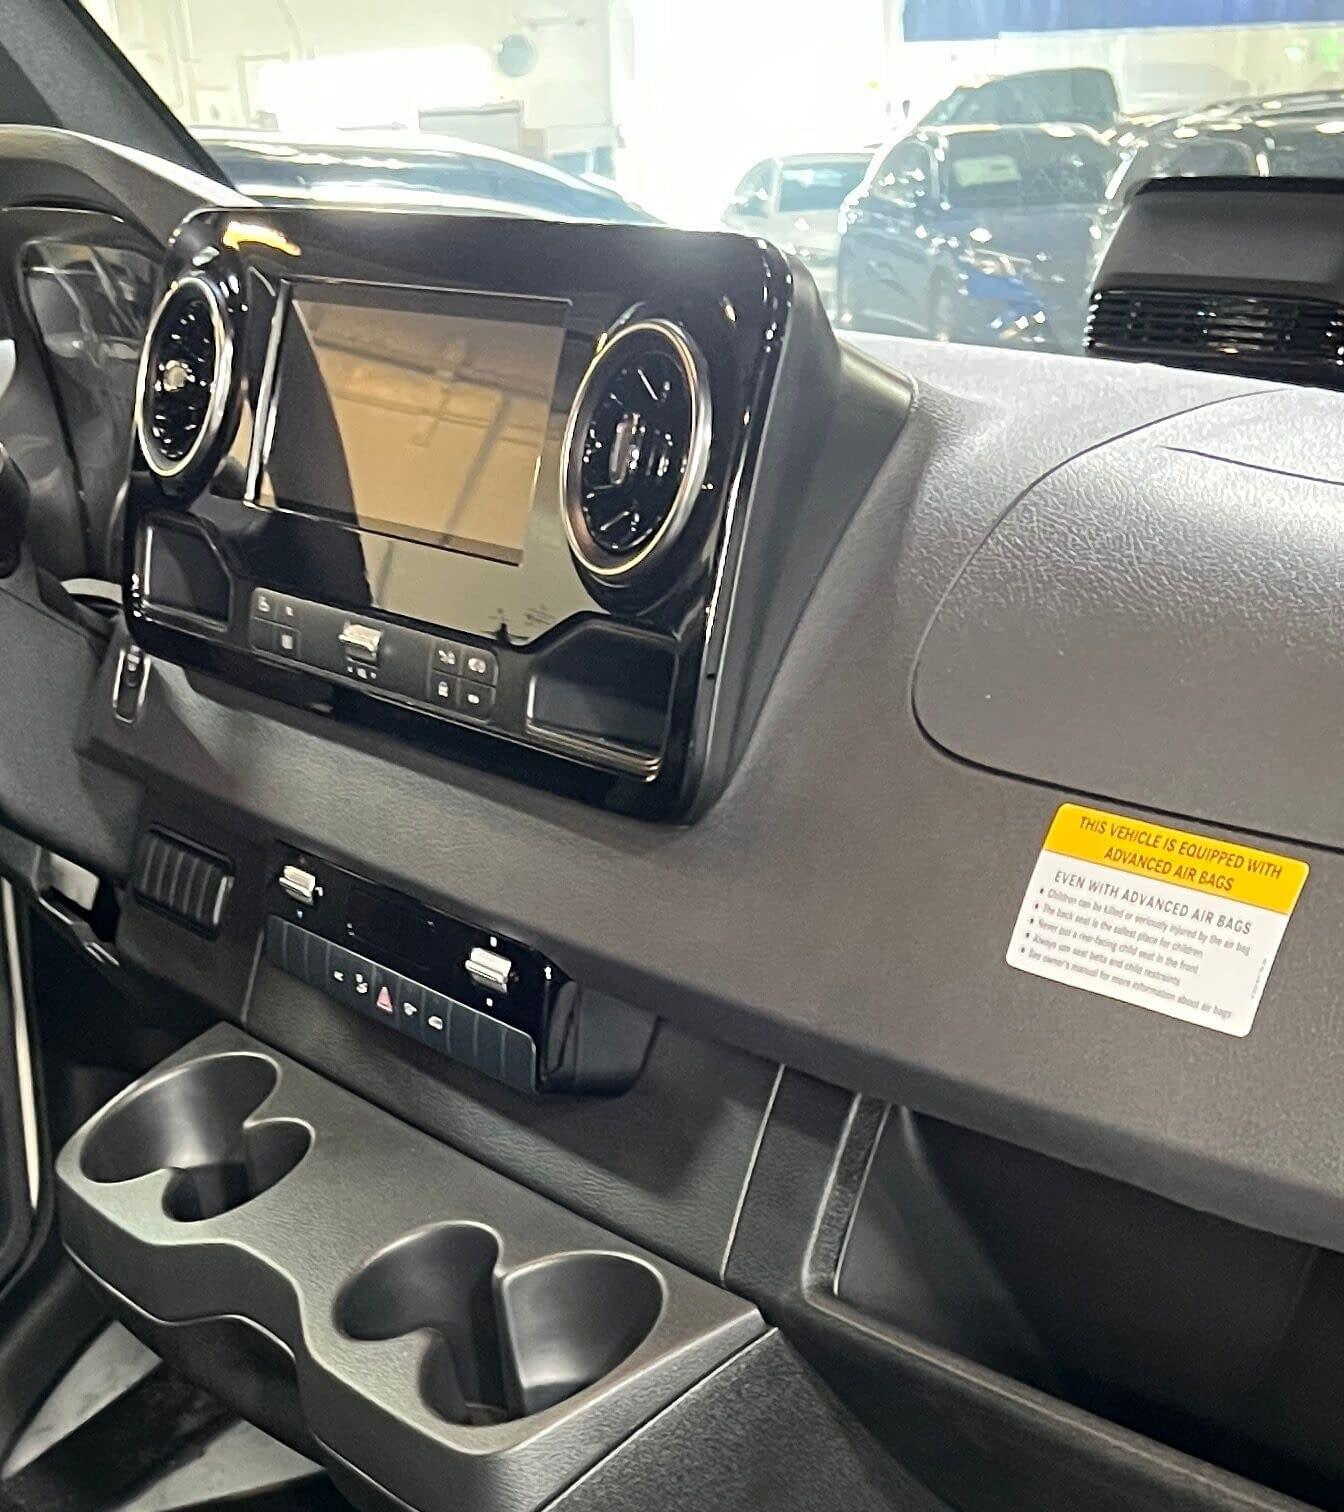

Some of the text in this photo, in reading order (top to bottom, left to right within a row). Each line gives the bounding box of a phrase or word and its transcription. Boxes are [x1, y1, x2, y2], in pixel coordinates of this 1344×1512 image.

[1079, 815, 1283, 879] THIS VEHICLE IS EQUIPPED WITH
[1105, 846, 1234, 891] ADVANCED AIR BAGS
[1055, 870, 1251, 935] EVEN WITH ADVANCED AIR BAGS
